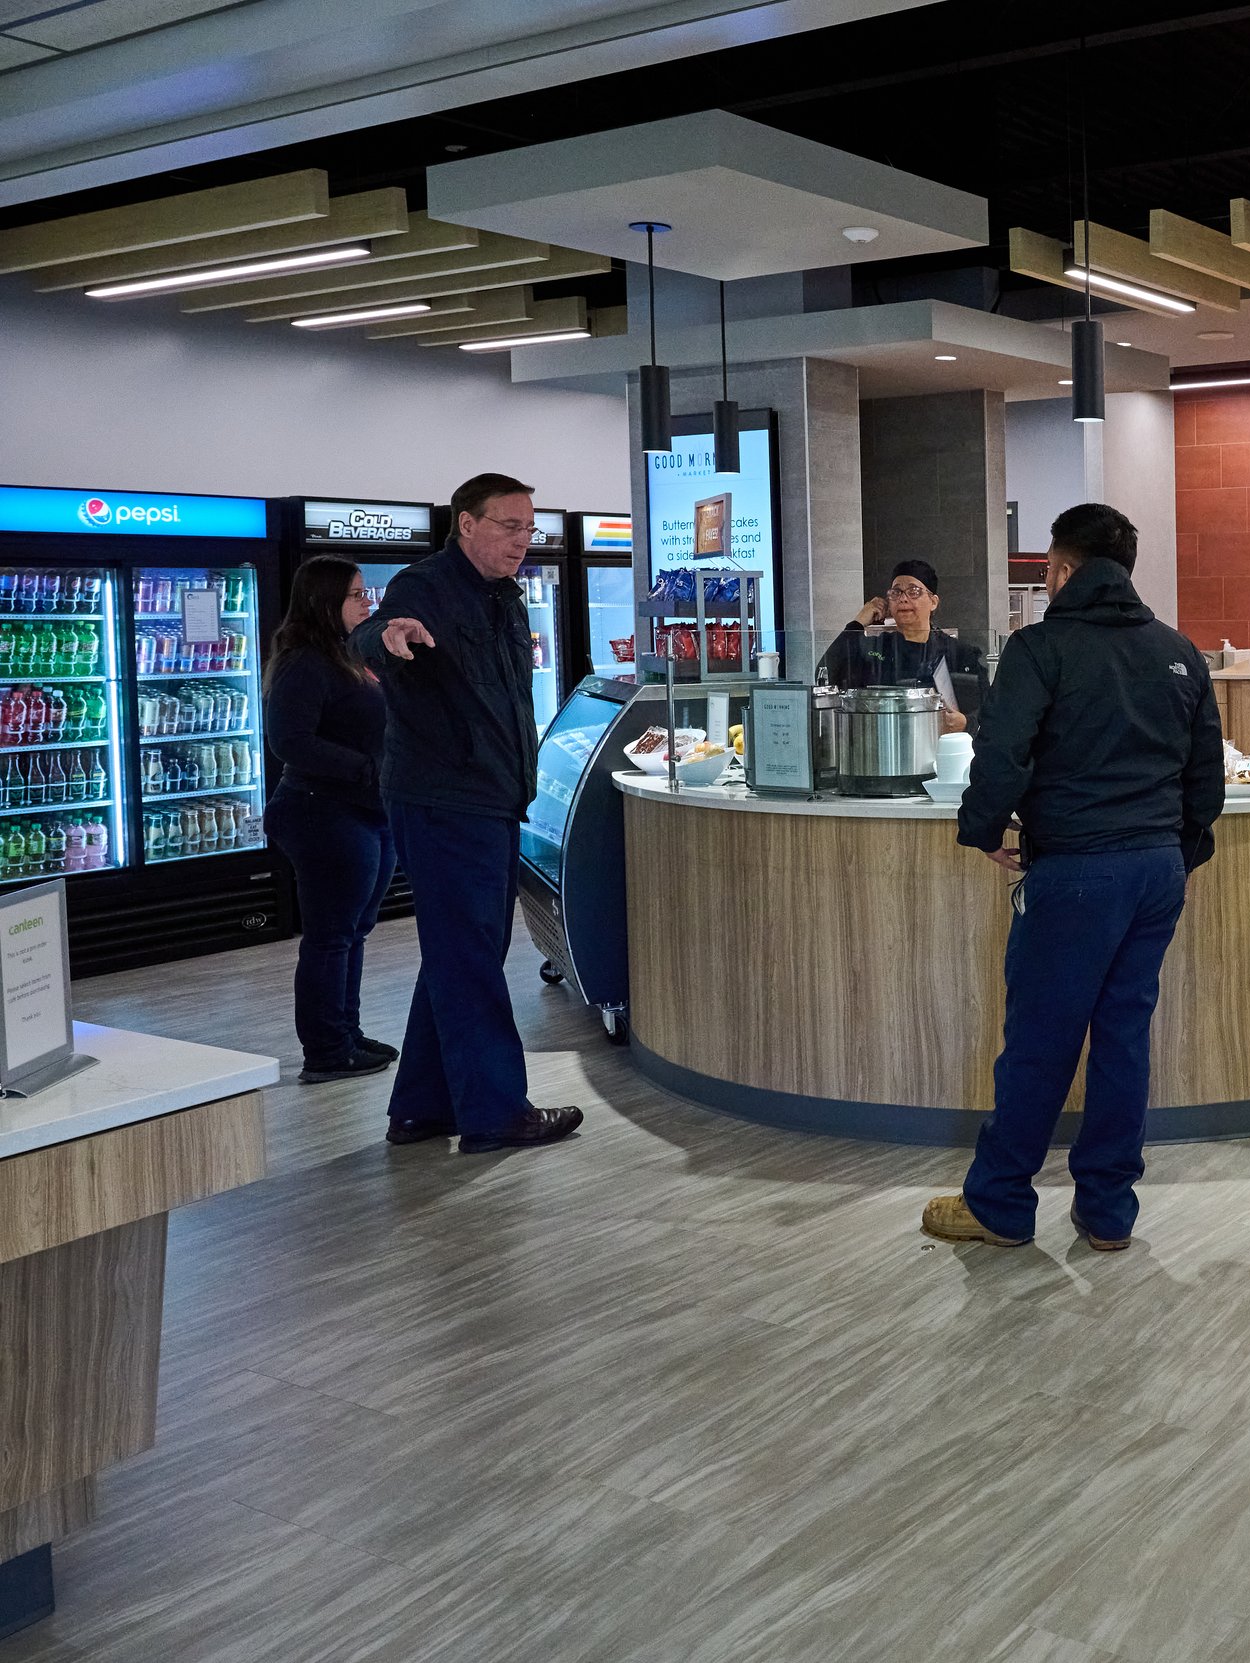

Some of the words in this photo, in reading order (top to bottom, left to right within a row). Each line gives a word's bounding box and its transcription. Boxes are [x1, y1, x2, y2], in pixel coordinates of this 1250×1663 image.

[654, 454, 683, 470] GOOD
[115, 504, 179, 526] pepsi
[349, 510, 392, 528] COLD
[731, 517, 759, 528] cakes
[328, 521, 413, 540] BEVERAGES
[661, 535, 680, 546] with
[741, 532, 761, 544] and
[667, 553, 674, 561] a
[676, 550, 694, 561] side
[8, 916, 44, 936] canteen
